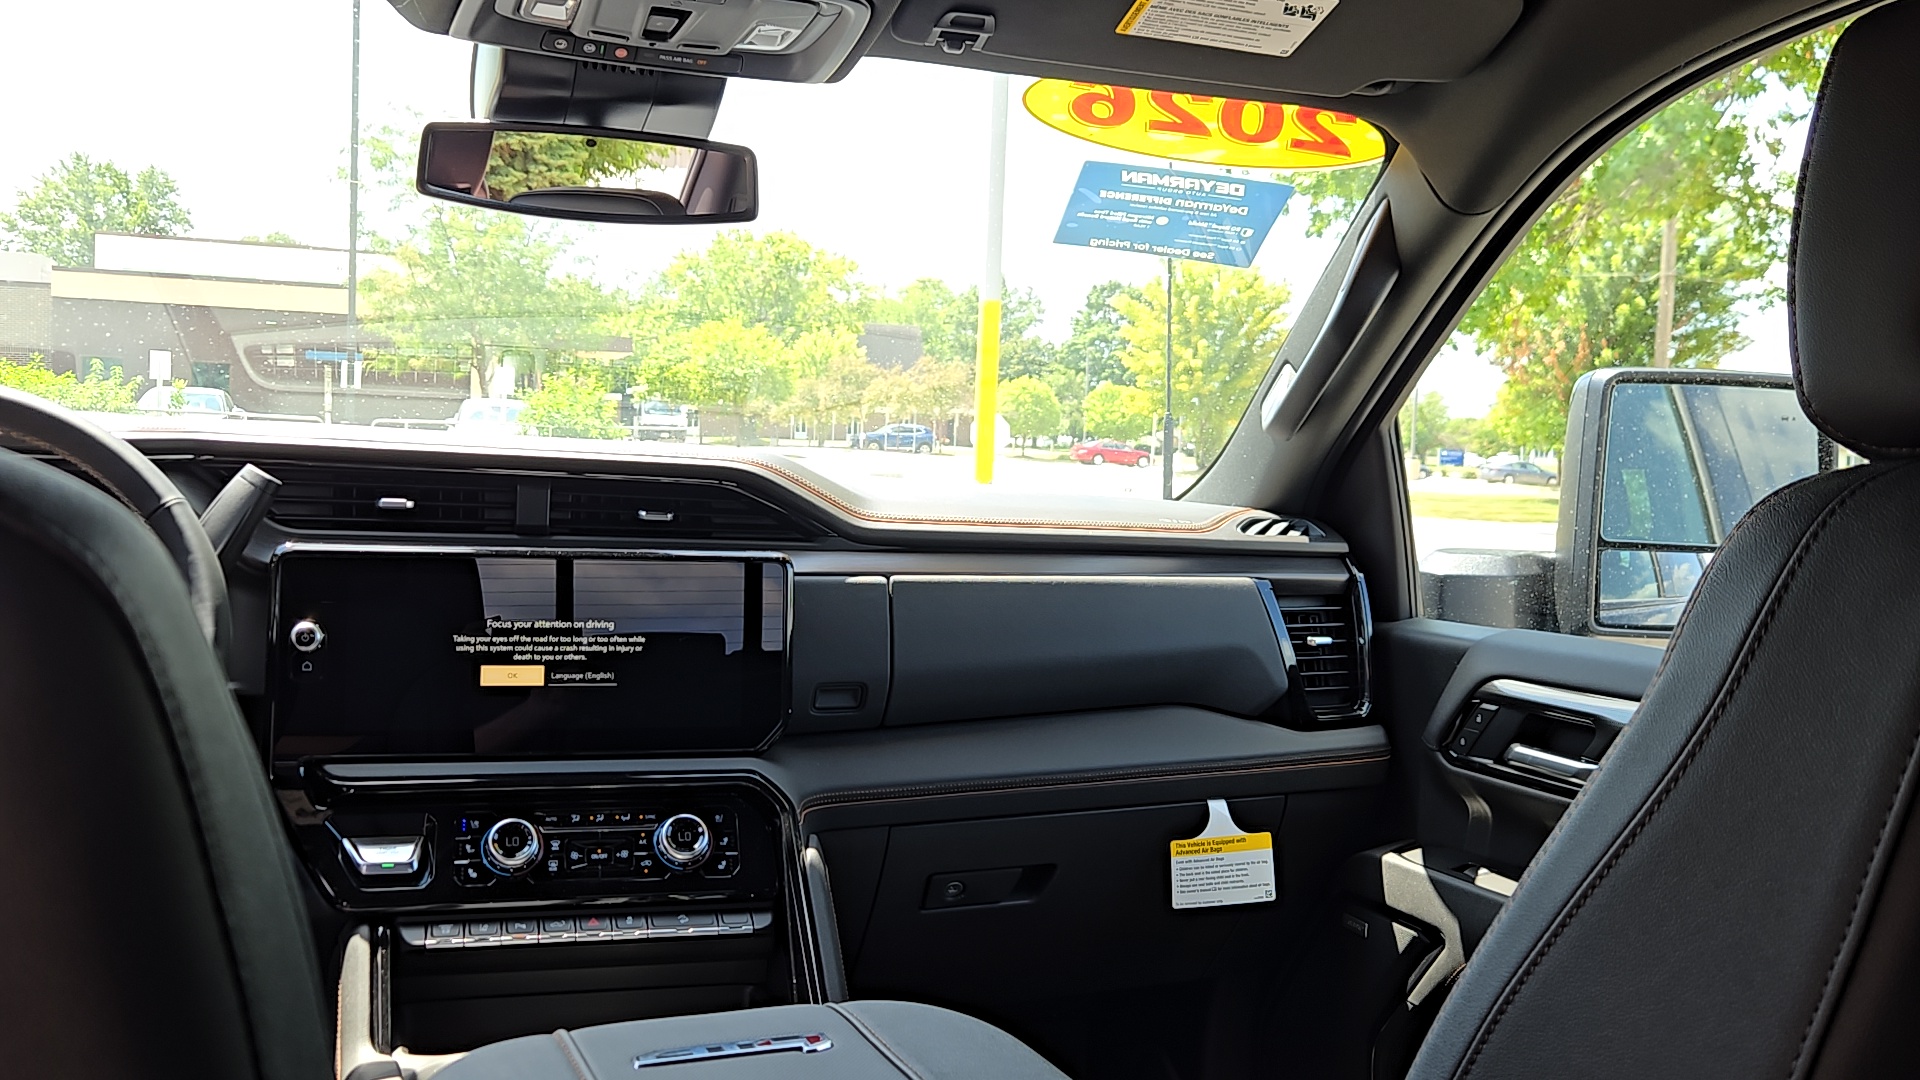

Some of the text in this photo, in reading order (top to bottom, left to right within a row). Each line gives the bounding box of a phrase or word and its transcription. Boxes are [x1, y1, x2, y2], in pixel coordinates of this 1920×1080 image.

[658, 54, 672, 62] PASS
[487, 619, 615, 631] Focus your attention on driving
[453, 635, 475, 645] Taking
[476, 636, 492, 645] your
[492, 636, 508, 645] eyes
[509, 635, 519, 643] off
[520, 635, 531, 643] the
[532, 635, 548, 643] road
[549, 635, 558, 643] for
[572, 635, 588, 645] long
[609, 635, 628, 643] often
[628, 635, 646, 643] while
[456, 645, 474, 654] using
[490, 646, 514, 654] system
[514, 644, 533, 652] could
[560, 644, 578, 652] crash
[507, 672, 518, 680] OK
[551, 672, 615, 682] Language (English)
[505, 836, 520, 848] LO
[678, 832, 692, 842] LO
[1187, 840, 1206, 848] Vehicle
[1212, 838, 1235, 846] Equipped
[1175, 848, 1201, 856] Advanced
